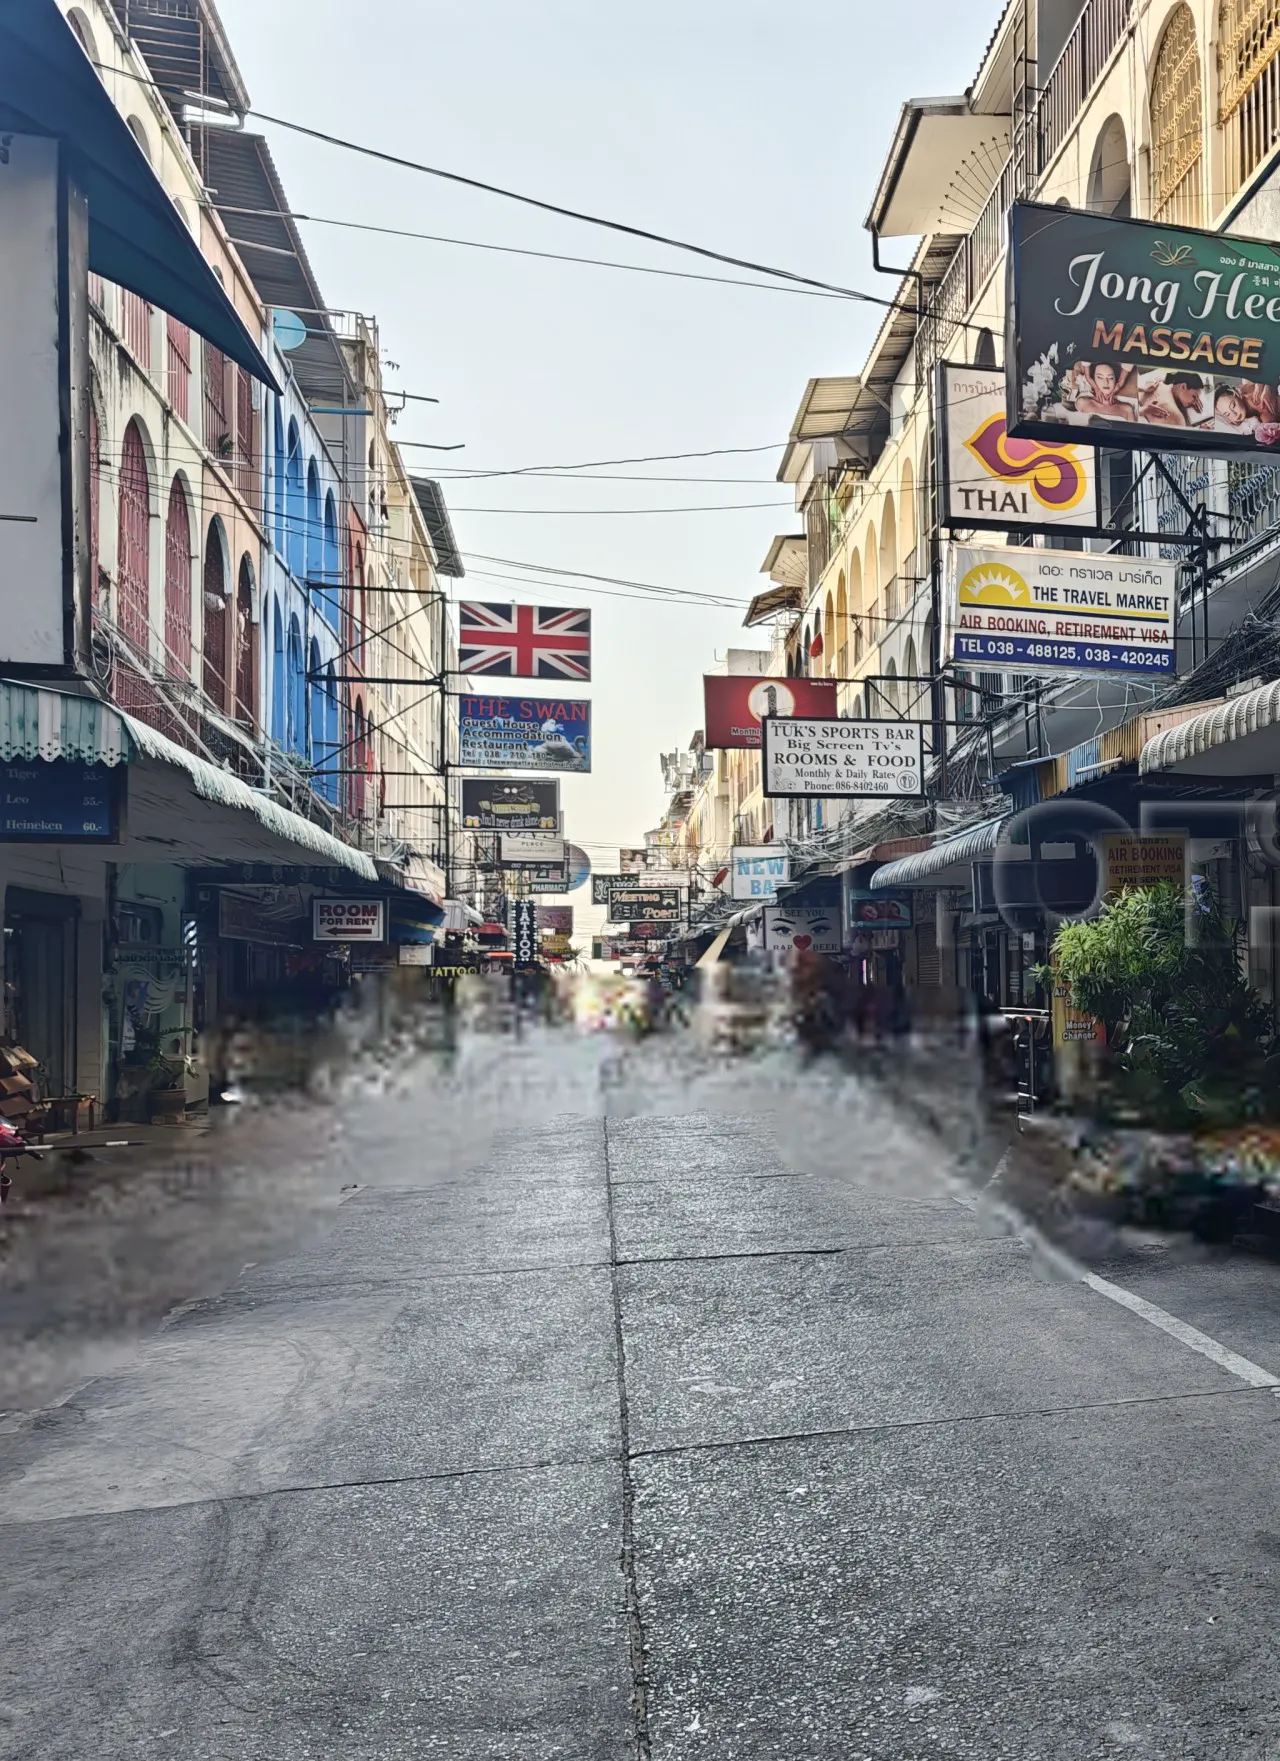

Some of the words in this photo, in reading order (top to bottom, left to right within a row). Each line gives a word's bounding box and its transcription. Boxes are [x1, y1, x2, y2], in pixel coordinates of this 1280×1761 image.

[1054, 250, 1181, 325] Jong
[1091, 319, 1264, 370] MASSAGE
[957, 487, 1029, 514] THAI
[1038, 564, 1064, 576] เดอะ
[1033, 586, 1058, 602] THE
[1063, 588, 1112, 607] TRAVEL
[1116, 593, 1170, 611] MARKET
[959, 614, 982, 630] AIR
[987, 616, 1051, 638] BOOKING,
[1055, 621, 1136, 642] RETIREMENT
[1140, 628, 1169, 644] VISA
[959, 638, 984, 653] TEL
[463, 698, 510, 717] THE
[520, 700, 587, 721] SWAN
[462, 718, 498, 728] Guest
[503, 720, 540, 730] House
[462, 728, 562, 741] Accommodation
[771, 725, 816, 738] TUK'S
[821, 726, 879, 739] SPORTS
[886, 728, 915, 740] BAR
[462, 739, 528, 751] Restaurant
[788, 739, 811, 751] Big
[816, 740, 864, 751] Screen
[872, 741, 902, 751] Tv's
[774, 752, 838, 765] ROOMS
[843, 754, 857, 766] &
[867, 755, 916, 767] FOOD
[6, 767, 39, 780] Tiger
[795, 768, 831, 781] Monthly
[834, 769, 843, 779] &
[846, 769, 868, 781] Daily
[872, 770, 896, 779] Rates
[6, 793, 30, 804] Leo
[6, 819, 63, 831] Heineken
[1107, 847, 1128, 862] AIR
[1132, 846, 1183, 861] BOOKING
[737, 857, 785, 876] NEW
[1109, 864, 1161, 875] RETIREMENT
[1163, 864, 1182, 873] VISA
[531, 884, 567, 892] PHARMACY
[319, 904, 378, 917] ROOM
[805, 909, 825, 917] YOU
[319, 917, 343, 926] FOR
[345, 917, 378, 926] RENT
[519, 902, 531, 958] TATTOO
[812, 943, 838, 951] BEER
[429, 966, 477, 977] TATTOO
[1054, 988, 1067, 997] Air
[1066, 1020, 1092, 1030] Money
